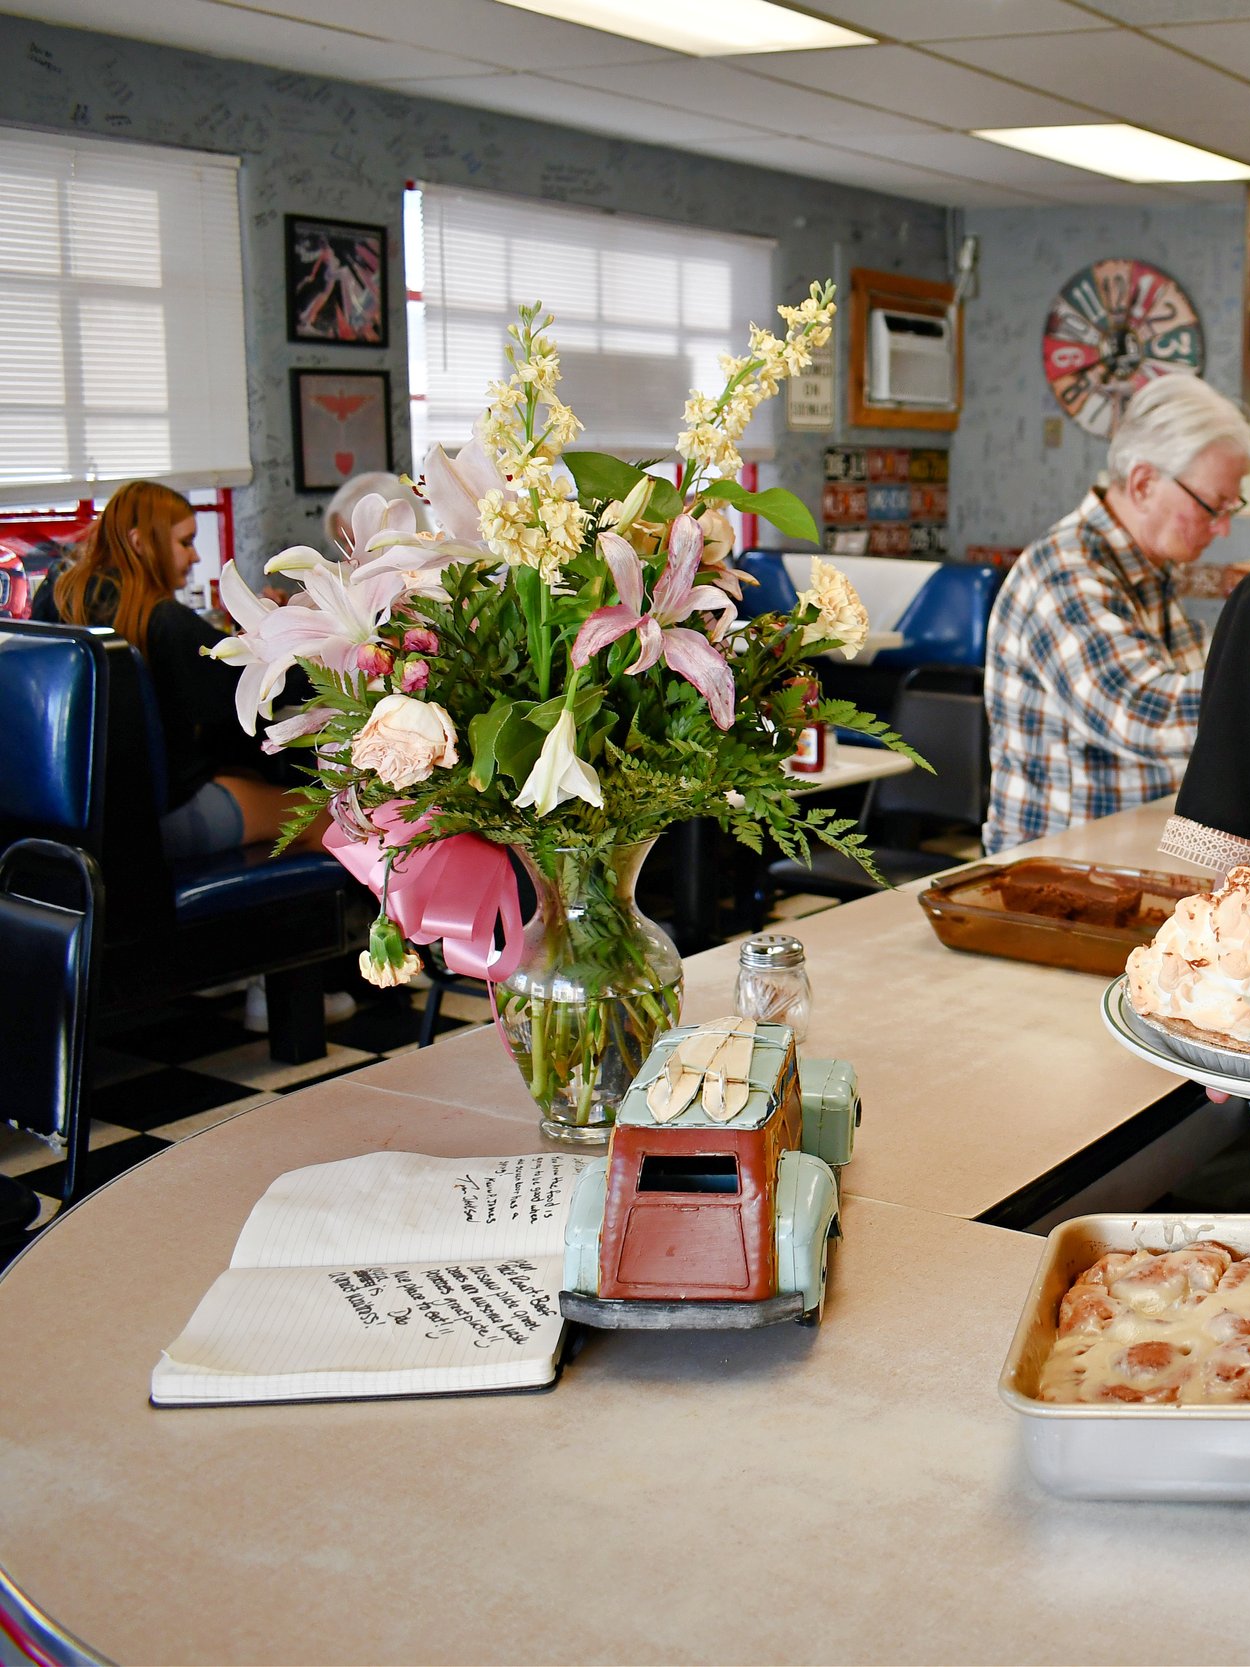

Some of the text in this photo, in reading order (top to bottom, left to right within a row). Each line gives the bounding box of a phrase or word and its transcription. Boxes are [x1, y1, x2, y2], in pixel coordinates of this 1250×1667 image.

[530, 1186, 545, 1202] good
[546, 1189, 561, 1207] food
[511, 1211, 519, 1220] a
[543, 1209, 553, 1219] is
